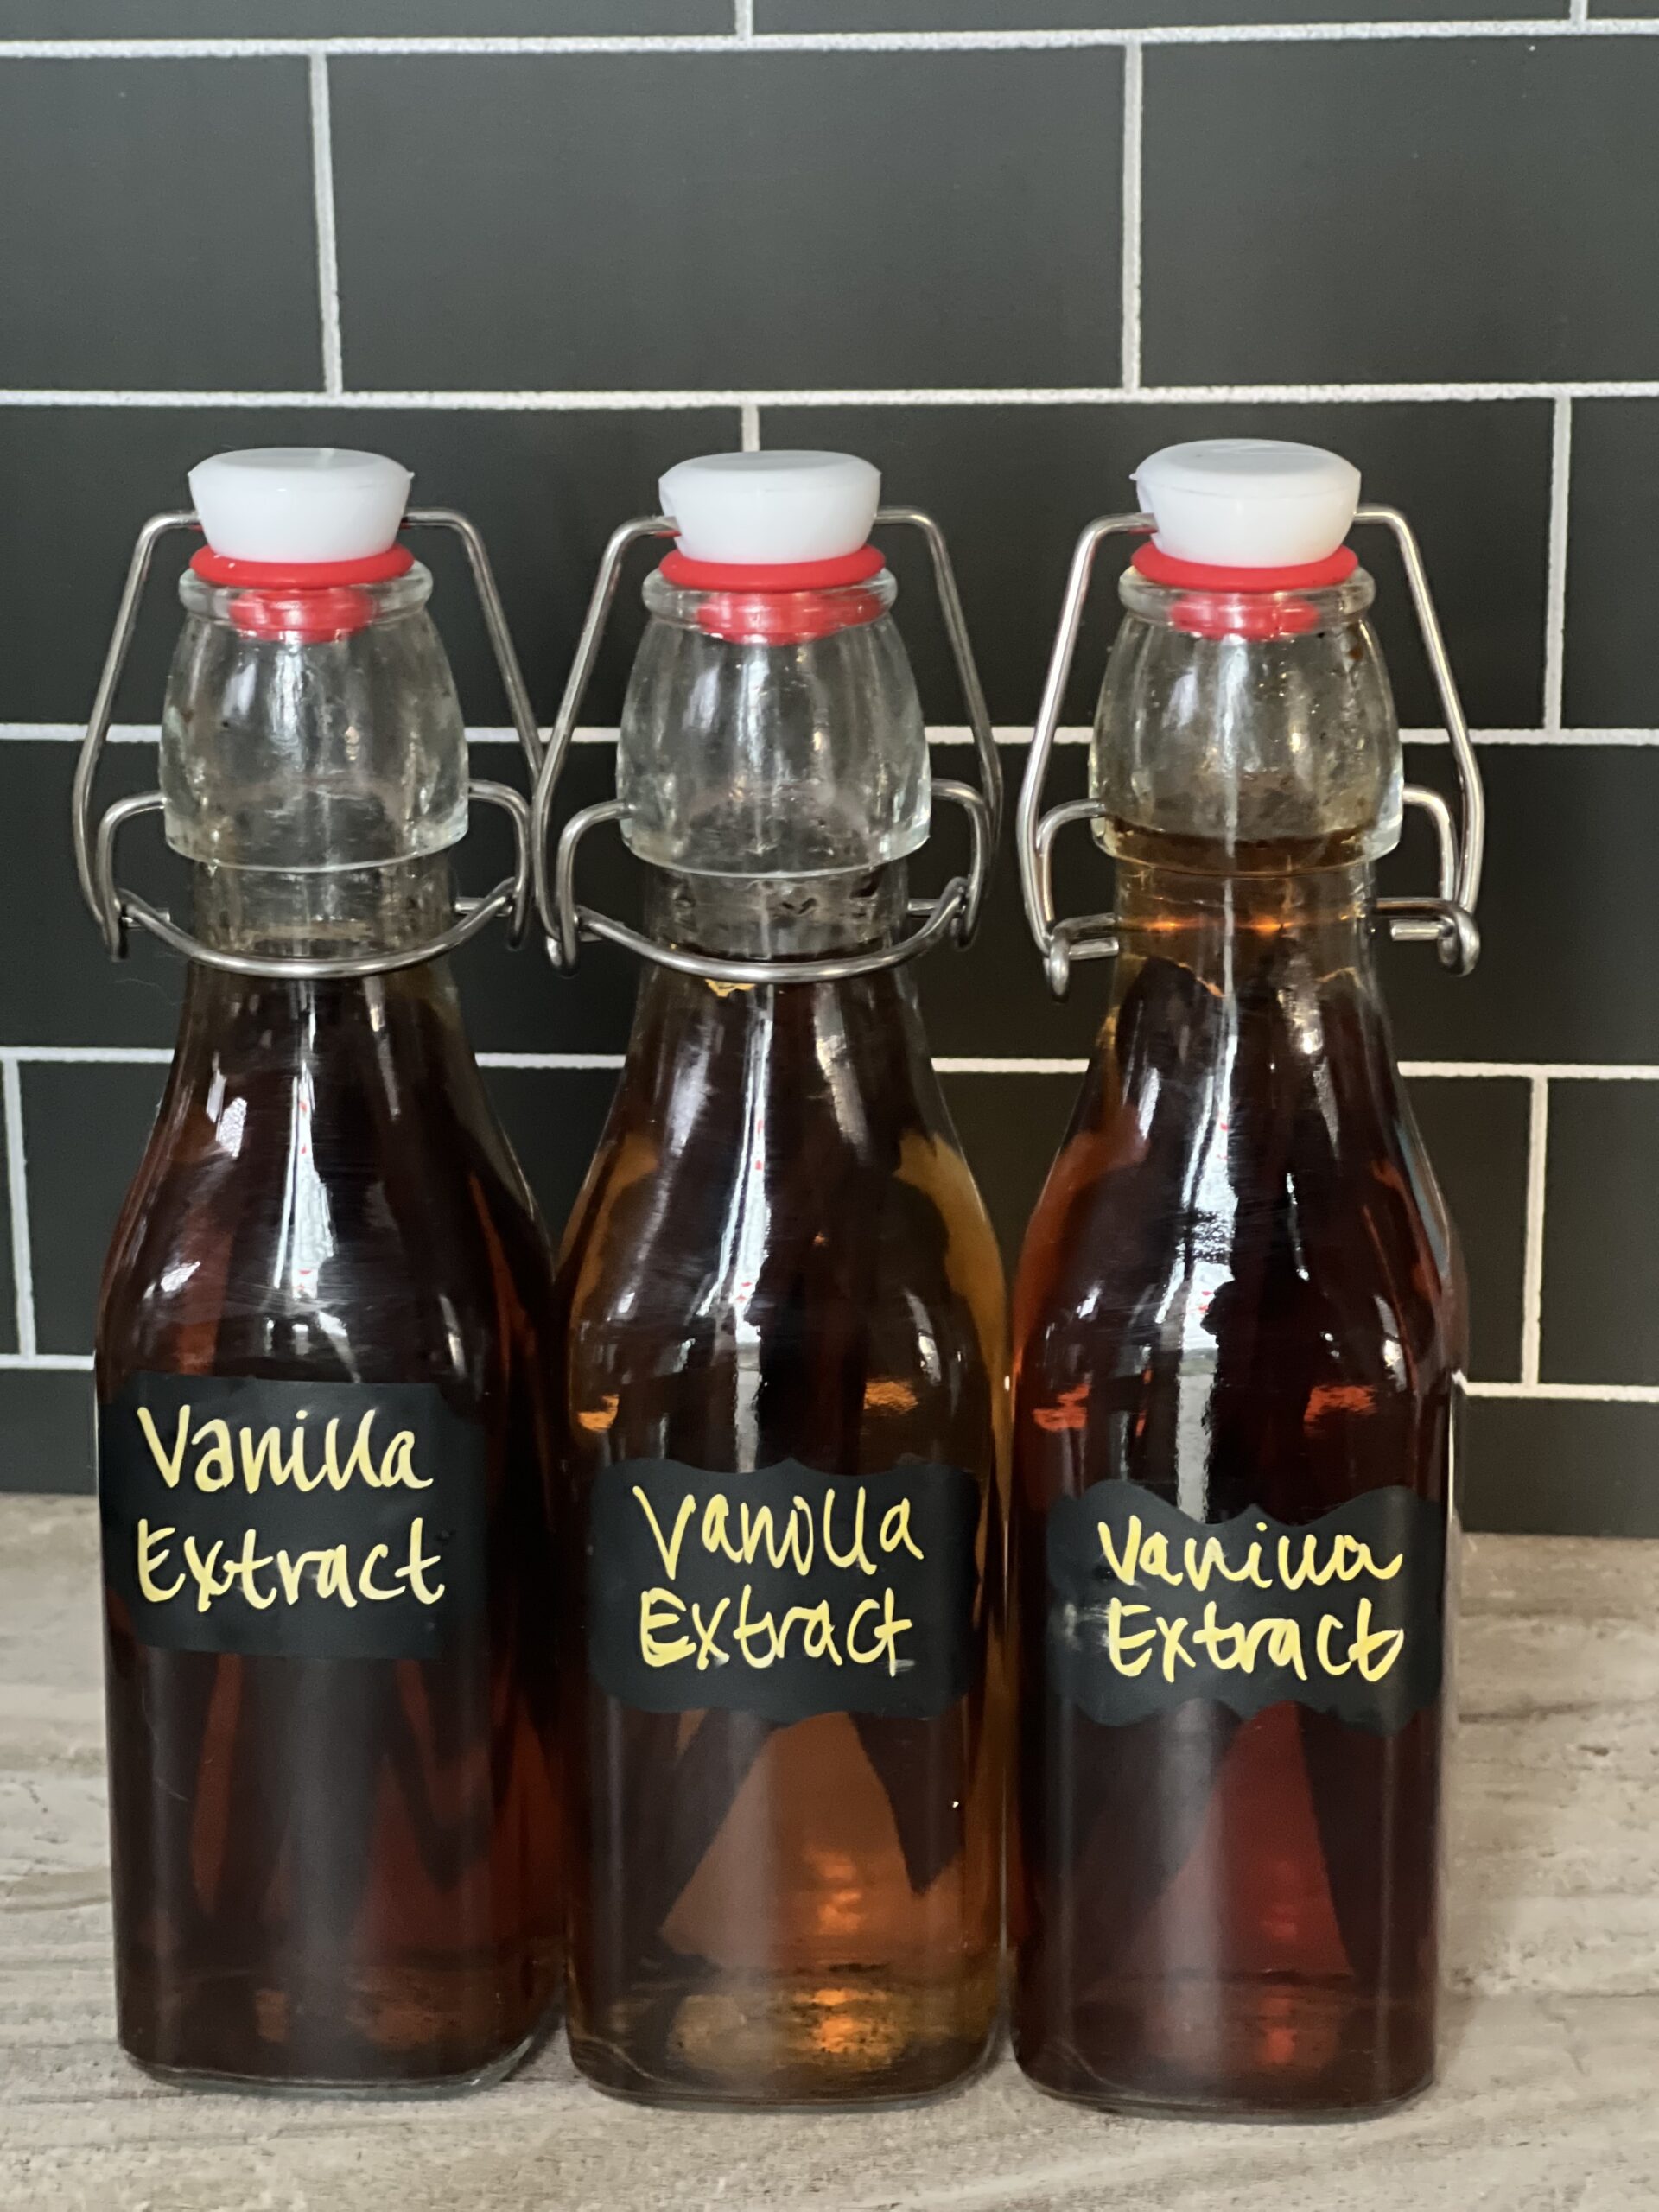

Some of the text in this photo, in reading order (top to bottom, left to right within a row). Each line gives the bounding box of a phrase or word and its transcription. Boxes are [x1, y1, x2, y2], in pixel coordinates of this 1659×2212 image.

[137, 1404, 434, 1494] Vanilla
[137, 1517, 445, 1613] Extract
[639, 1584, 913, 1677] Extract
[1106, 1597, 1405, 1683] Extract
